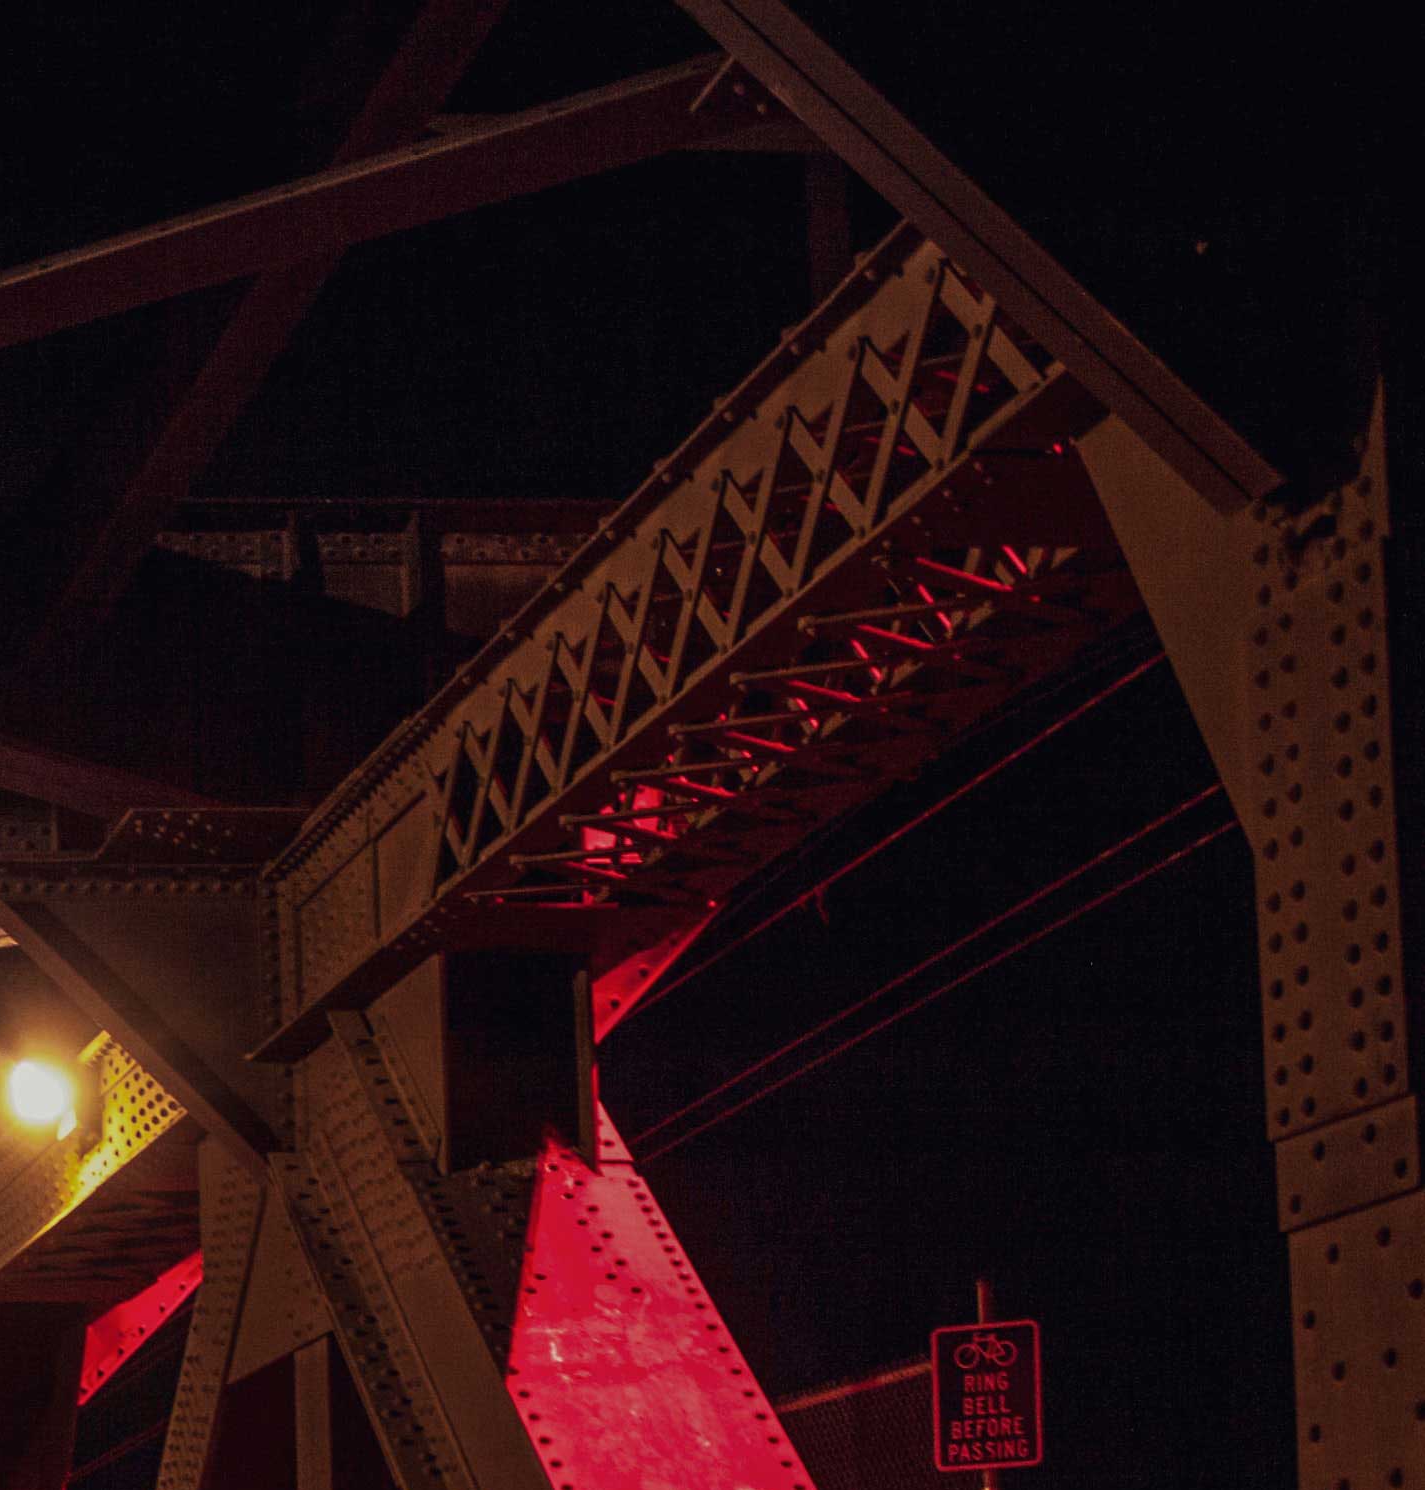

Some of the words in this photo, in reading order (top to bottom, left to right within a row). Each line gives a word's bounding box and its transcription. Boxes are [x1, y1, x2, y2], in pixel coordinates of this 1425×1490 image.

[964, 1371, 1011, 1392] RING
[962, 1395, 1012, 1416] BELL
[951, 1416, 1025, 1439] BEFORE
[948, 1439, 1030, 1462] PASSING
